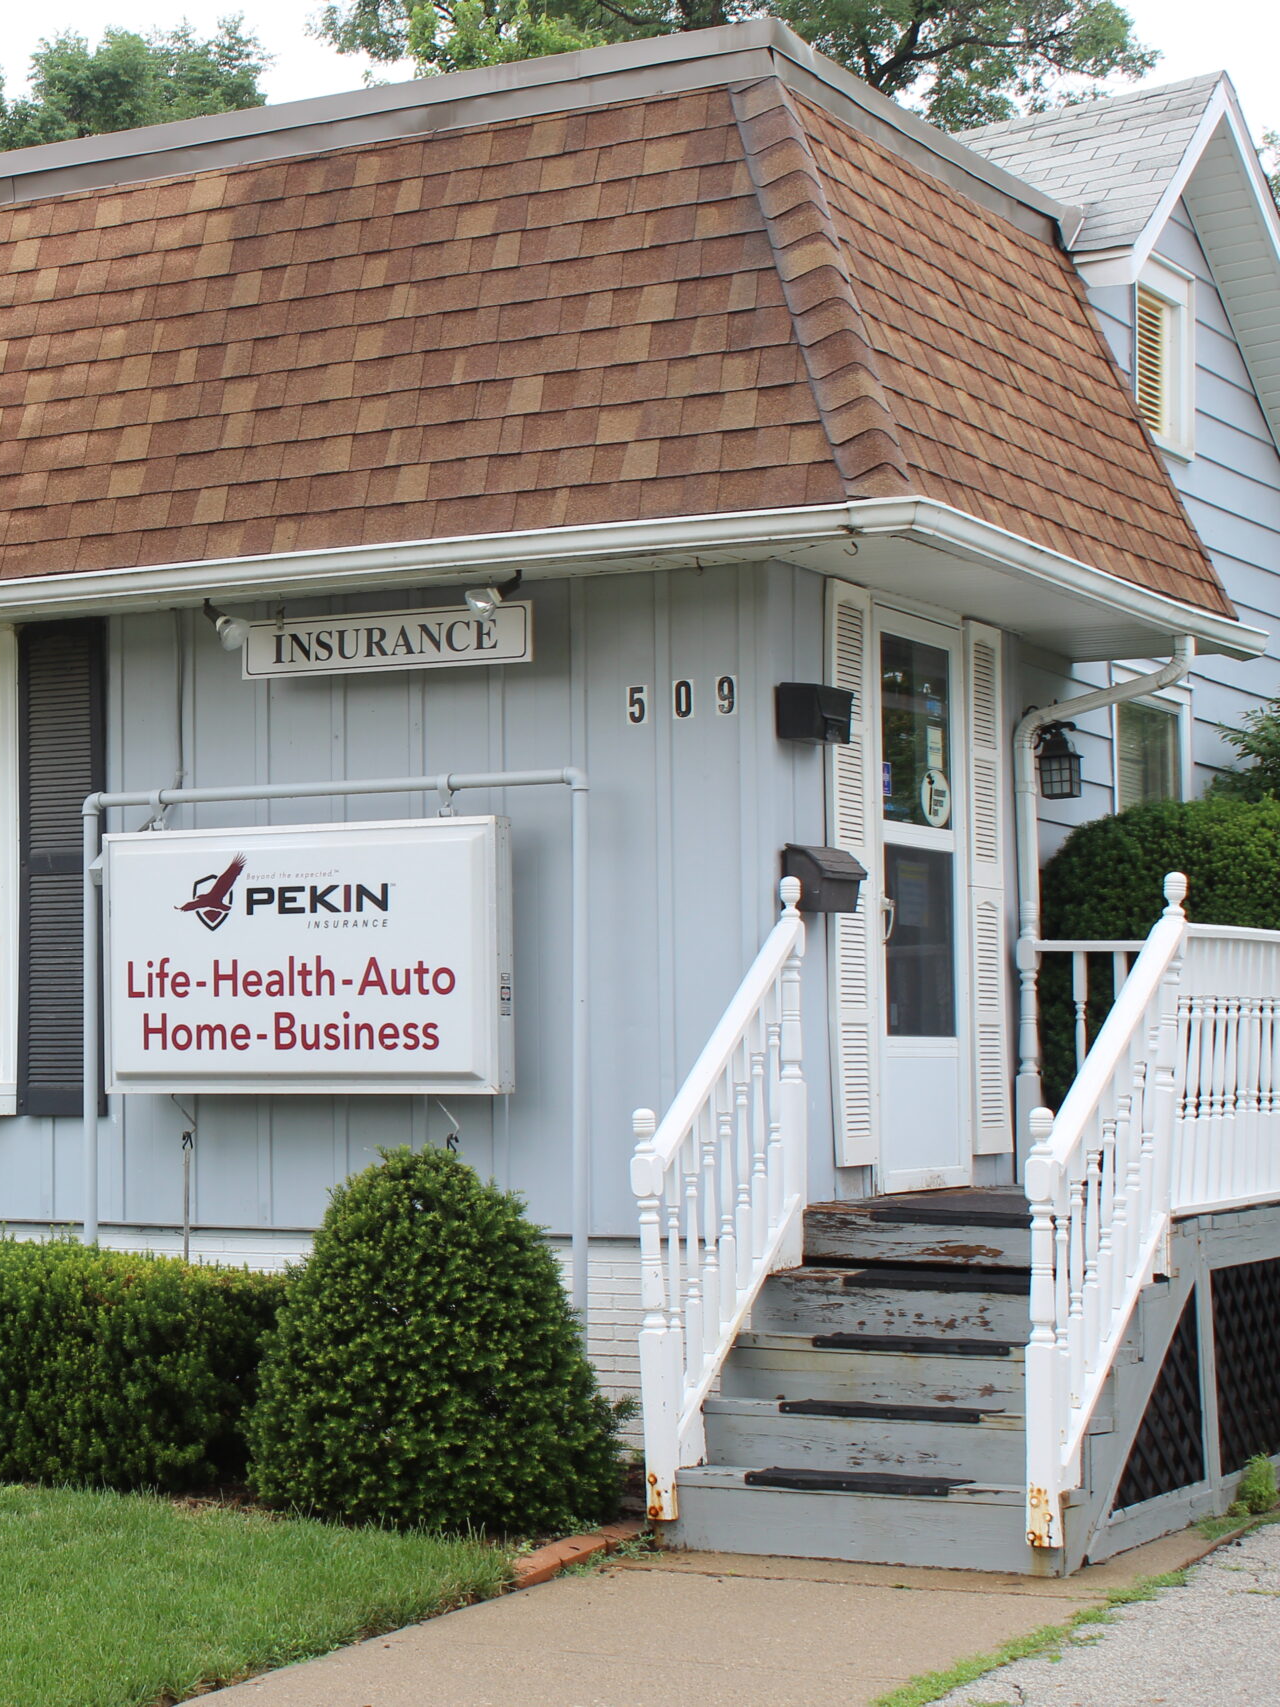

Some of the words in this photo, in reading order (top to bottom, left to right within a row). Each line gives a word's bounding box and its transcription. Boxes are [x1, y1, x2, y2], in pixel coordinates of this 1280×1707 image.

[271, 617, 499, 664] INSURANCE
[246, 872, 276, 881] Beyond
[279, 871, 291, 879] the
[246, 882, 389, 916] PEKIN
[307, 918, 388, 929] INSURANCE
[127, 955, 456, 999] Life-Health-Auto
[143, 1011, 440, 1051] Home-Business
